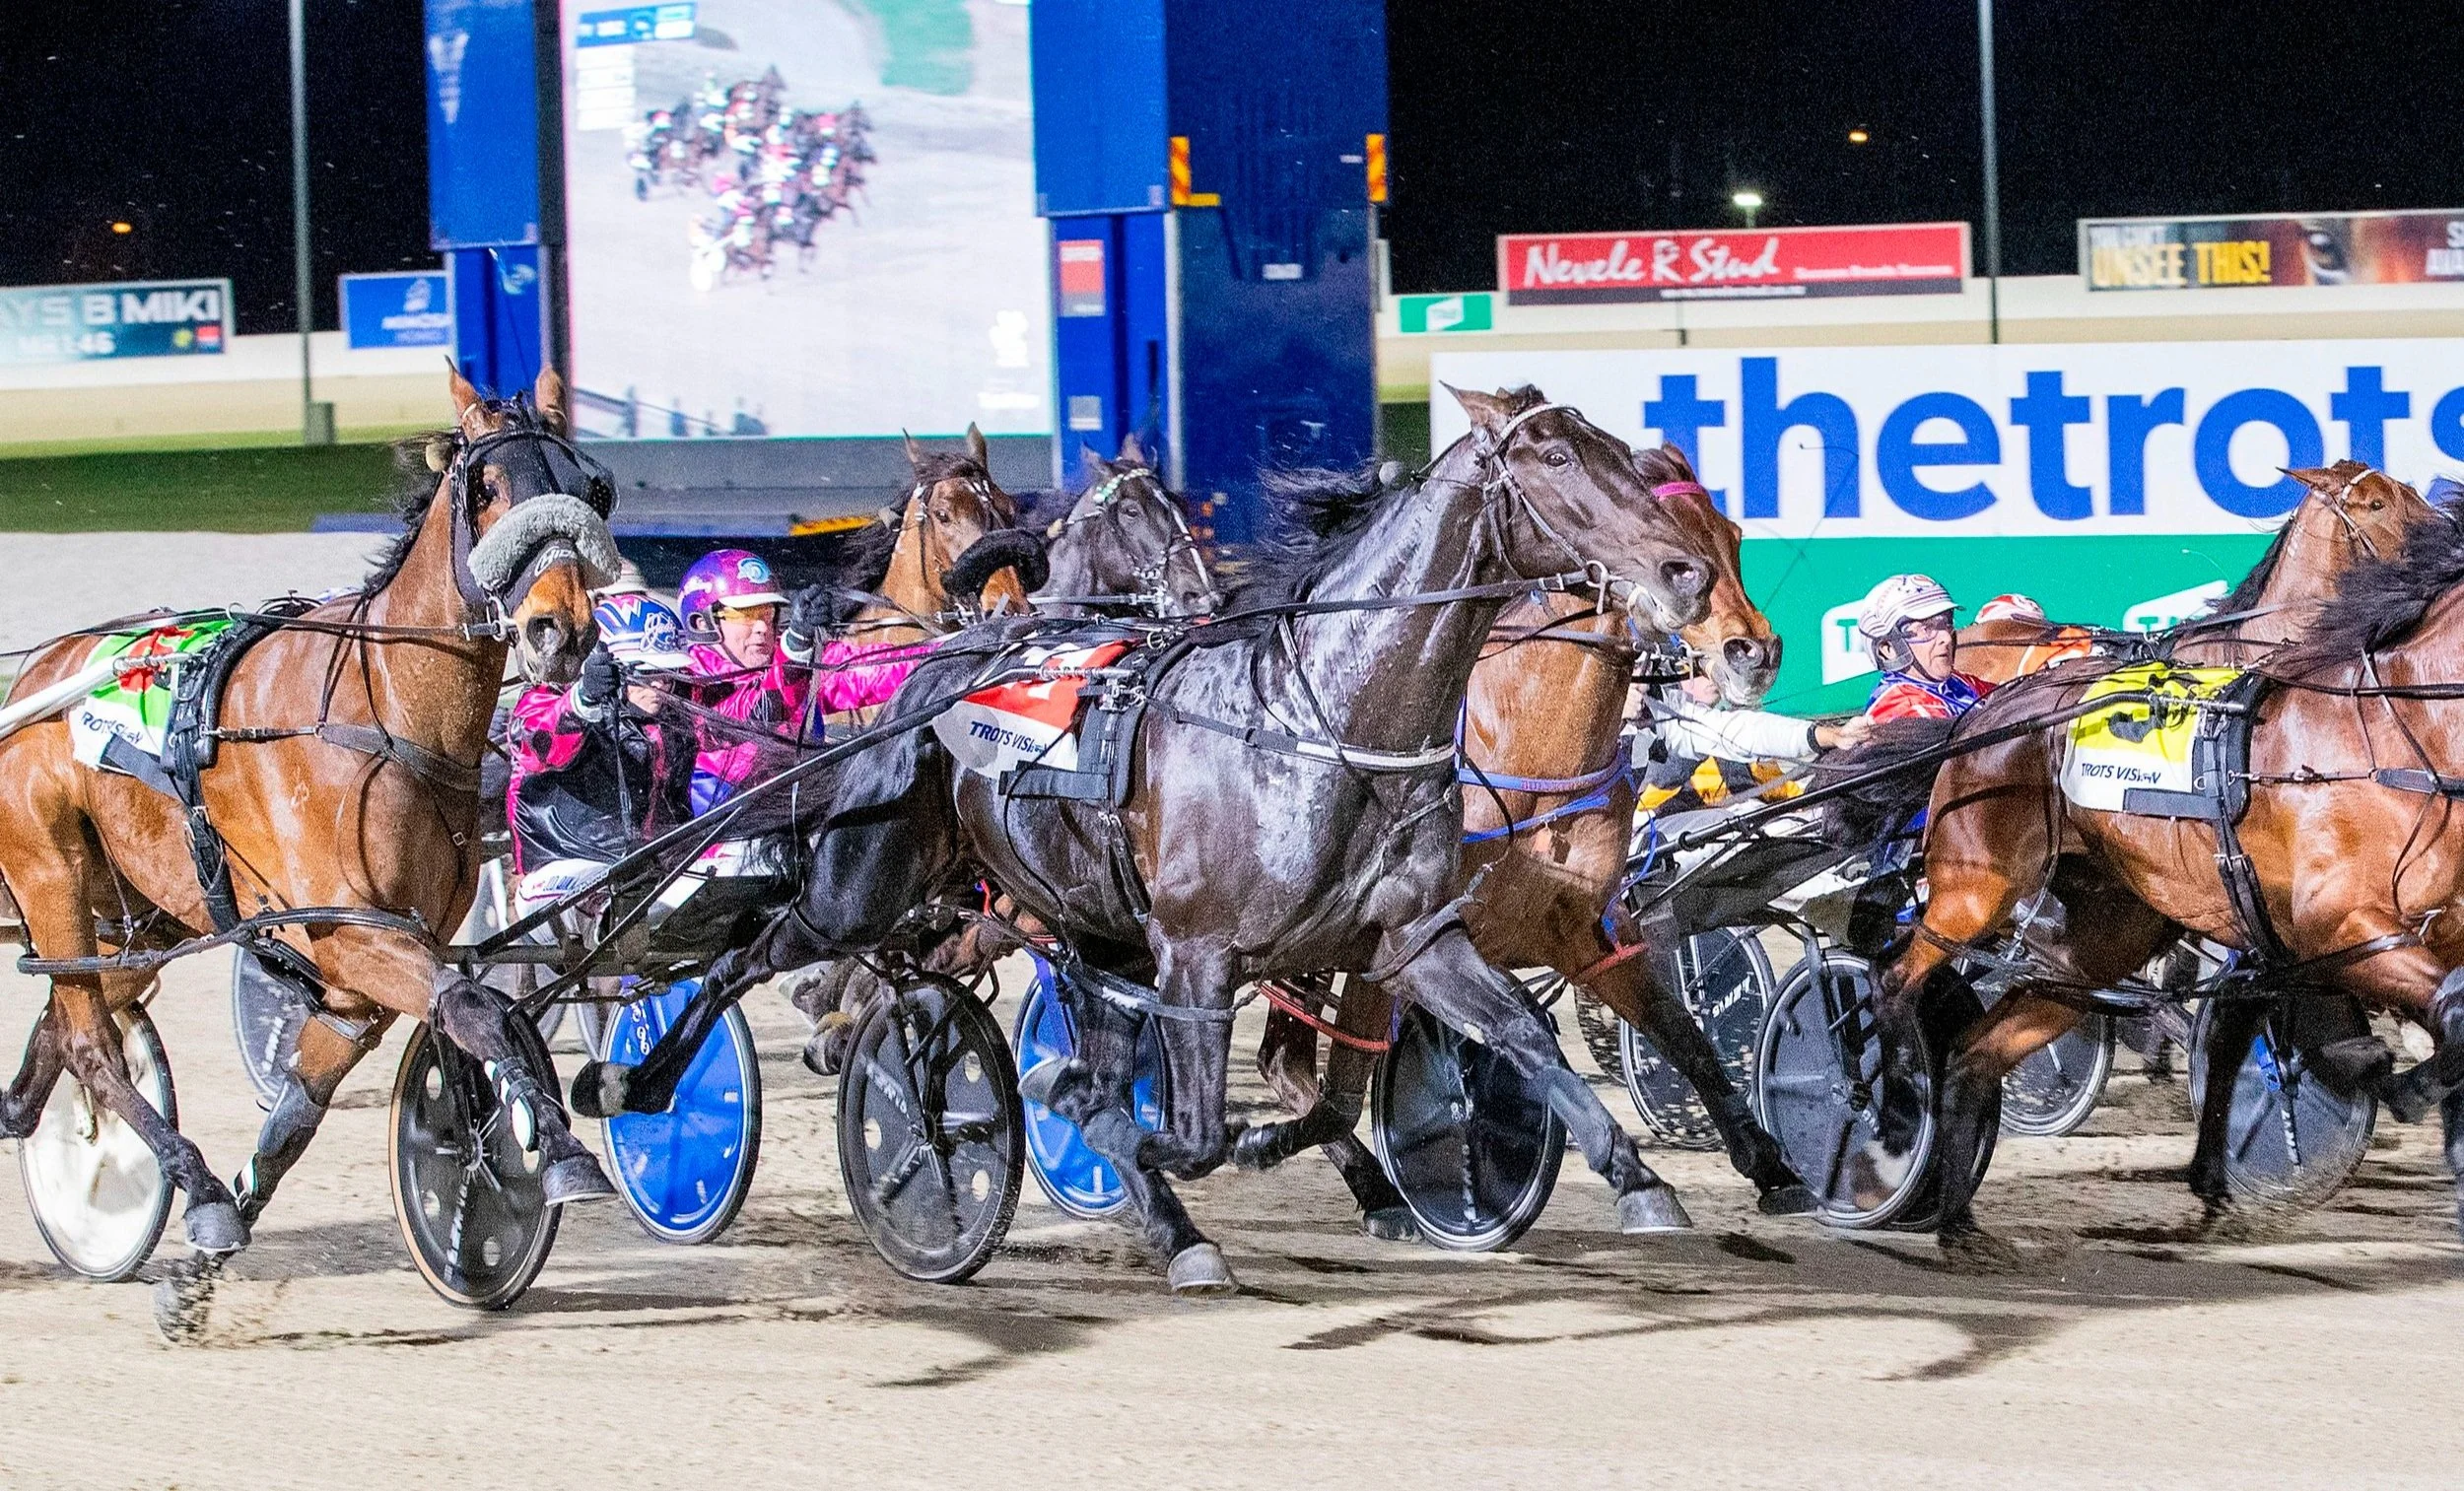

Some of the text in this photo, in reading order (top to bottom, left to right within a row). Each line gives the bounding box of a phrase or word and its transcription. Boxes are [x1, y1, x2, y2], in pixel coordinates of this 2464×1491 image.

[1523, 237, 1780, 288] Nevele R Stud
[2192, 239, 2272, 285] THIS!
[83, 295, 115, 324] B
[121, 290, 220, 323] MIKI
[1643, 357, 2464, 520] thetrot
[969, 720, 1013, 746] TROTS
[2082, 763, 2115, 779] TROTS
